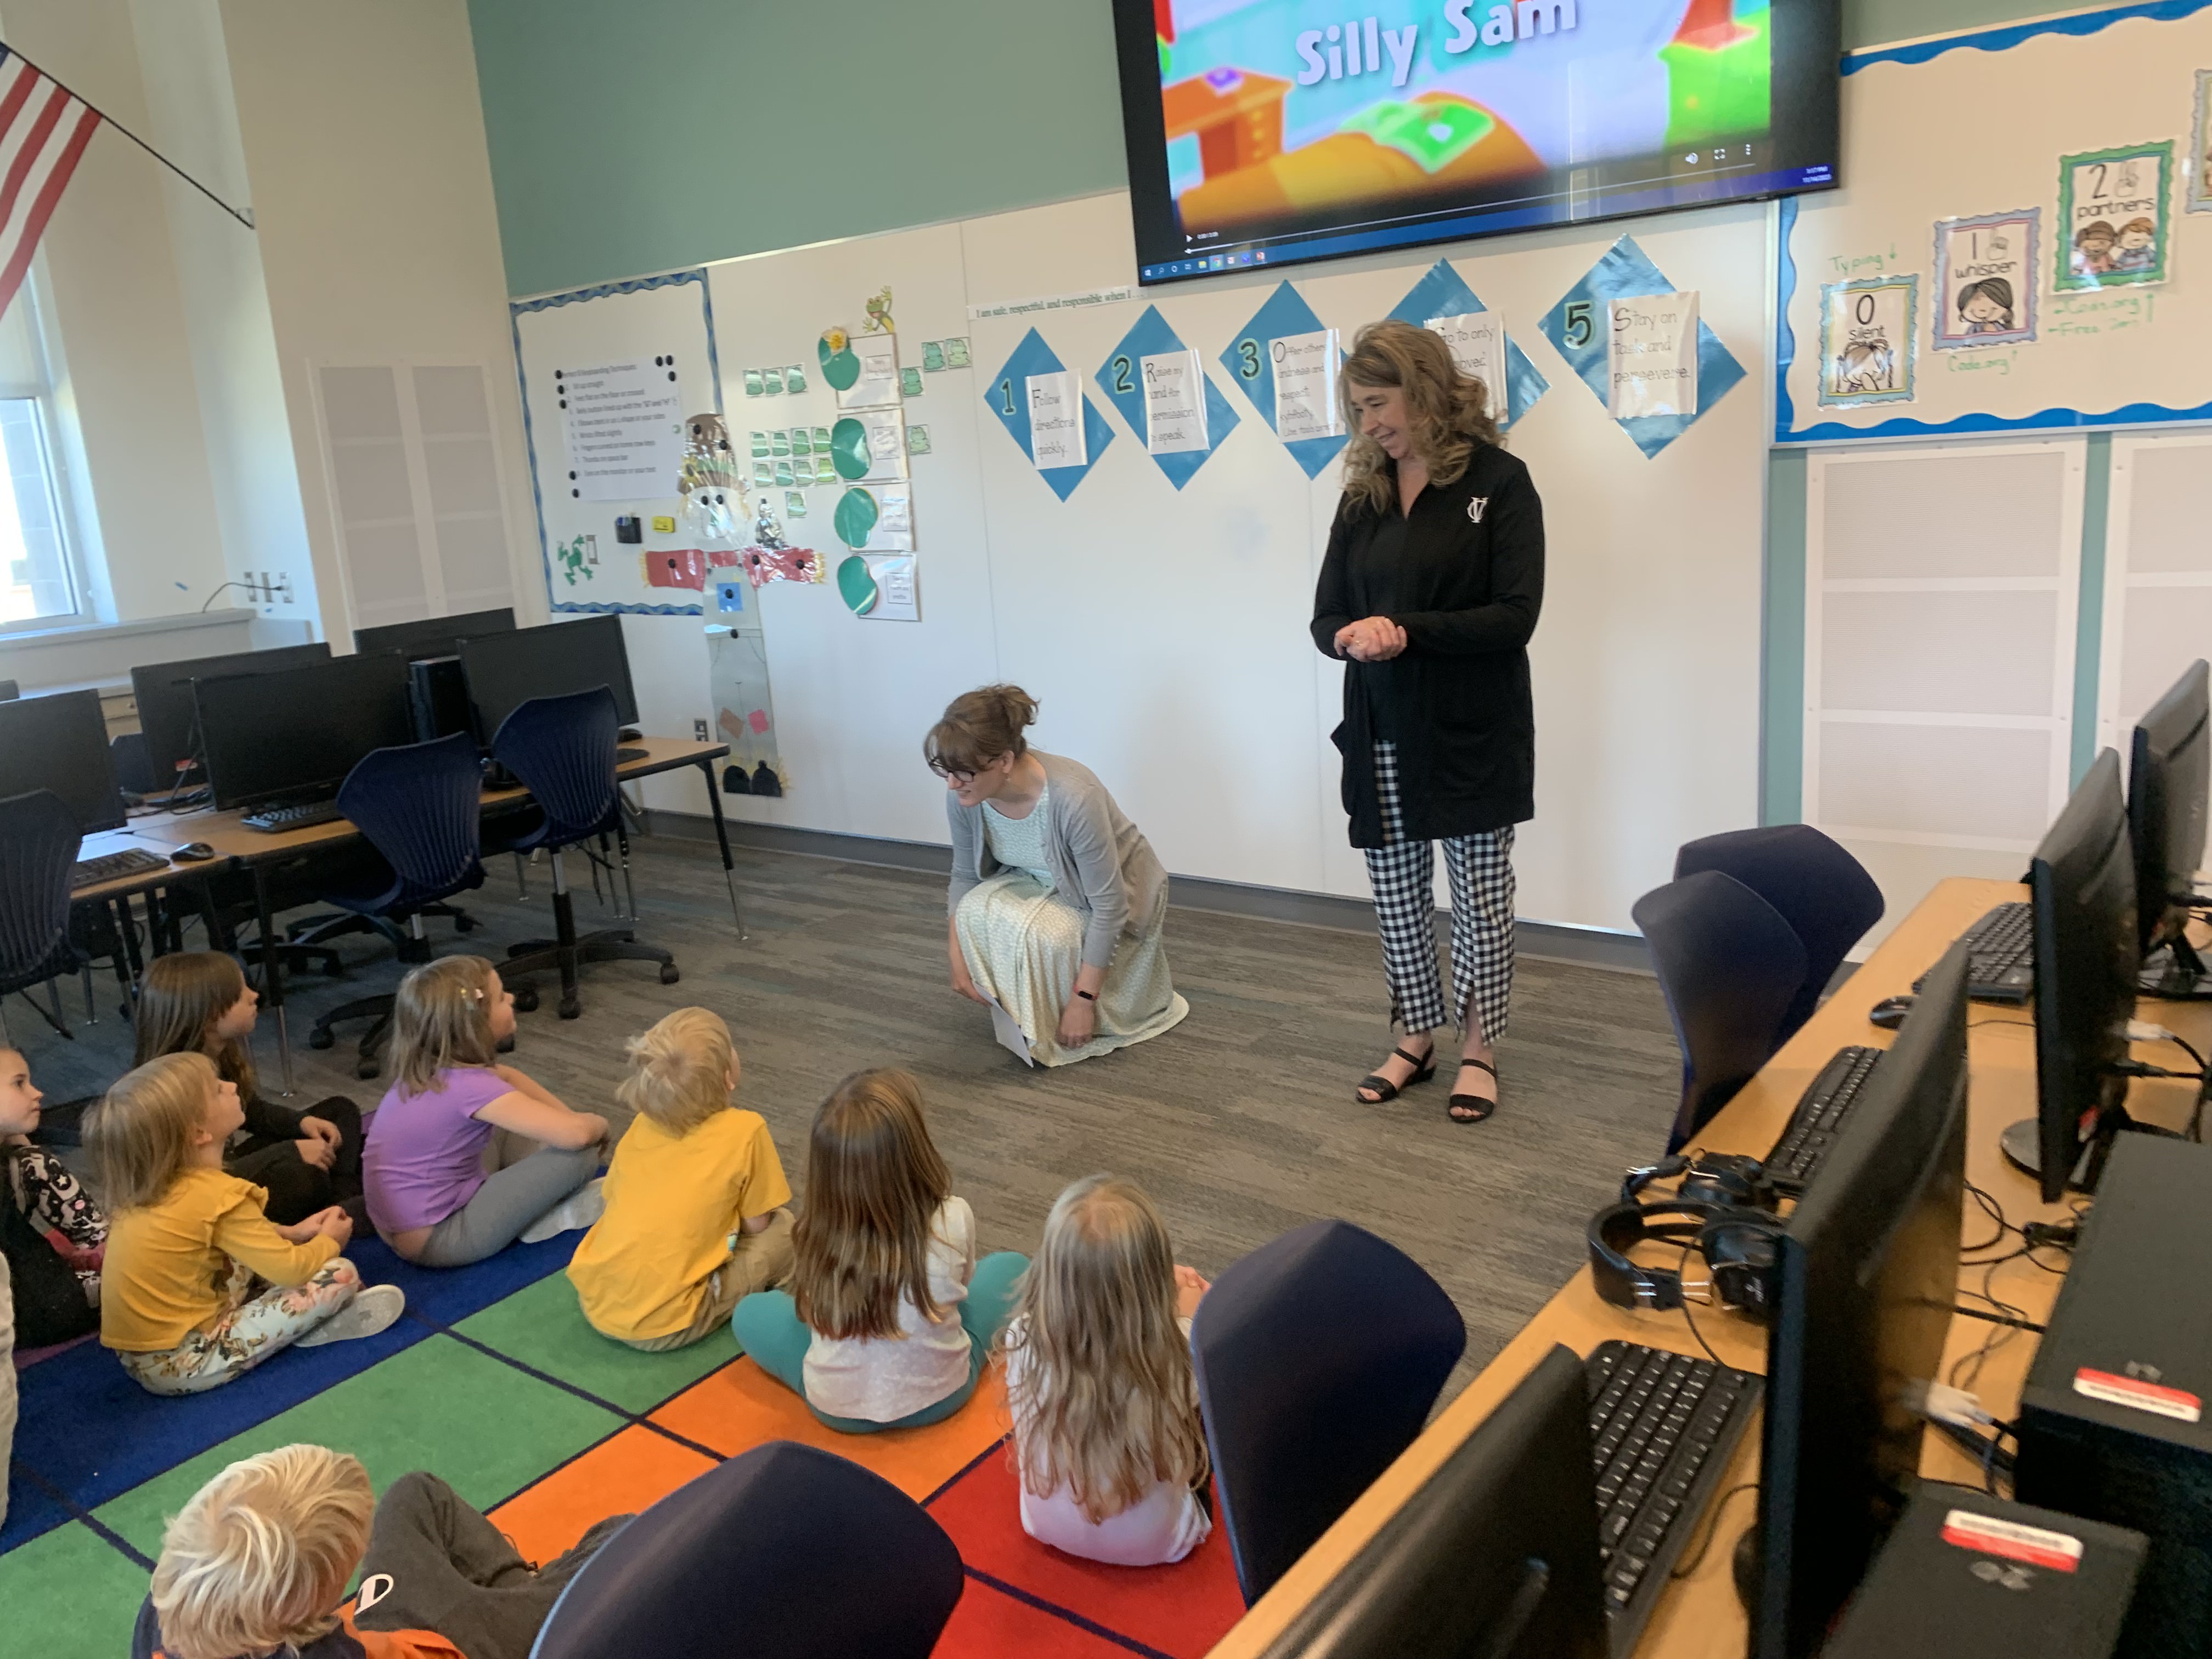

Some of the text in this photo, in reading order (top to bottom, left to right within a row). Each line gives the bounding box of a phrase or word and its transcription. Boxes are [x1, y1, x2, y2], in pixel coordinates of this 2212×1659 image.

[1295, 0, 1577, 87] Silly Sam
[2089, 164, 2108, 199] 2
[2077, 198, 2156, 221] partners
[1955, 261, 2017, 279] whisper
[1614, 307, 1677, 331] Stay on
[1855, 294, 1875, 325] 0
[1471, 324, 1495, 342] only
[1566, 302, 1592, 348] 5
[1848, 324, 1887, 340] silent
[1612, 335, 1672, 356] task and
[1239, 340, 1260, 379] 3
[1113, 356, 1134, 392] 2
[1146, 362, 1172, 383] Raise
[1613, 368, 1691, 389] persevere
[1001, 379, 1015, 414] 1
[1031, 388, 1061, 409] Follow
[1150, 407, 1194, 421] ermission
